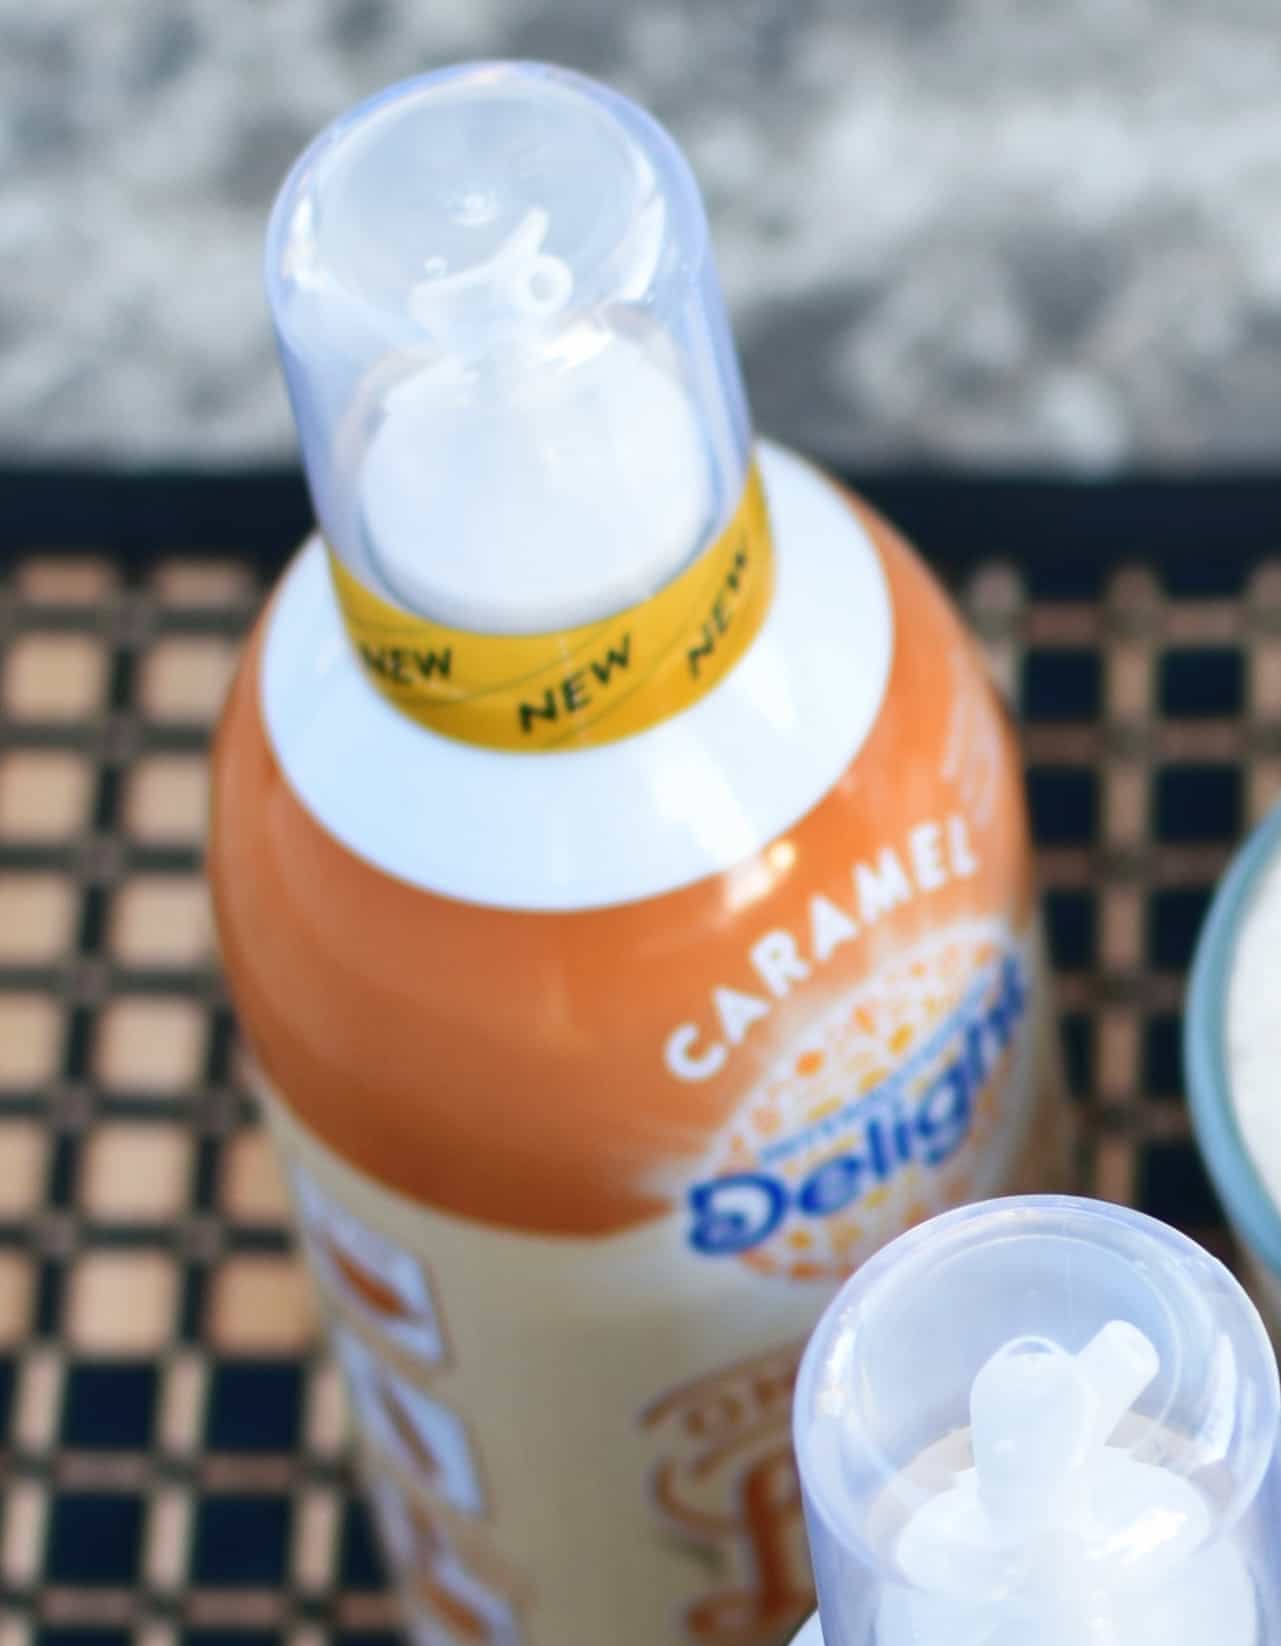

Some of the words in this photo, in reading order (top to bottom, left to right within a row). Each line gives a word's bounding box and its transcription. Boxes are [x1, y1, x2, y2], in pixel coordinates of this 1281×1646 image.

[359, 642, 453, 685] NEW
[517, 632, 632, 735] NEW
[664, 813, 980, 1084] CARAMEL
